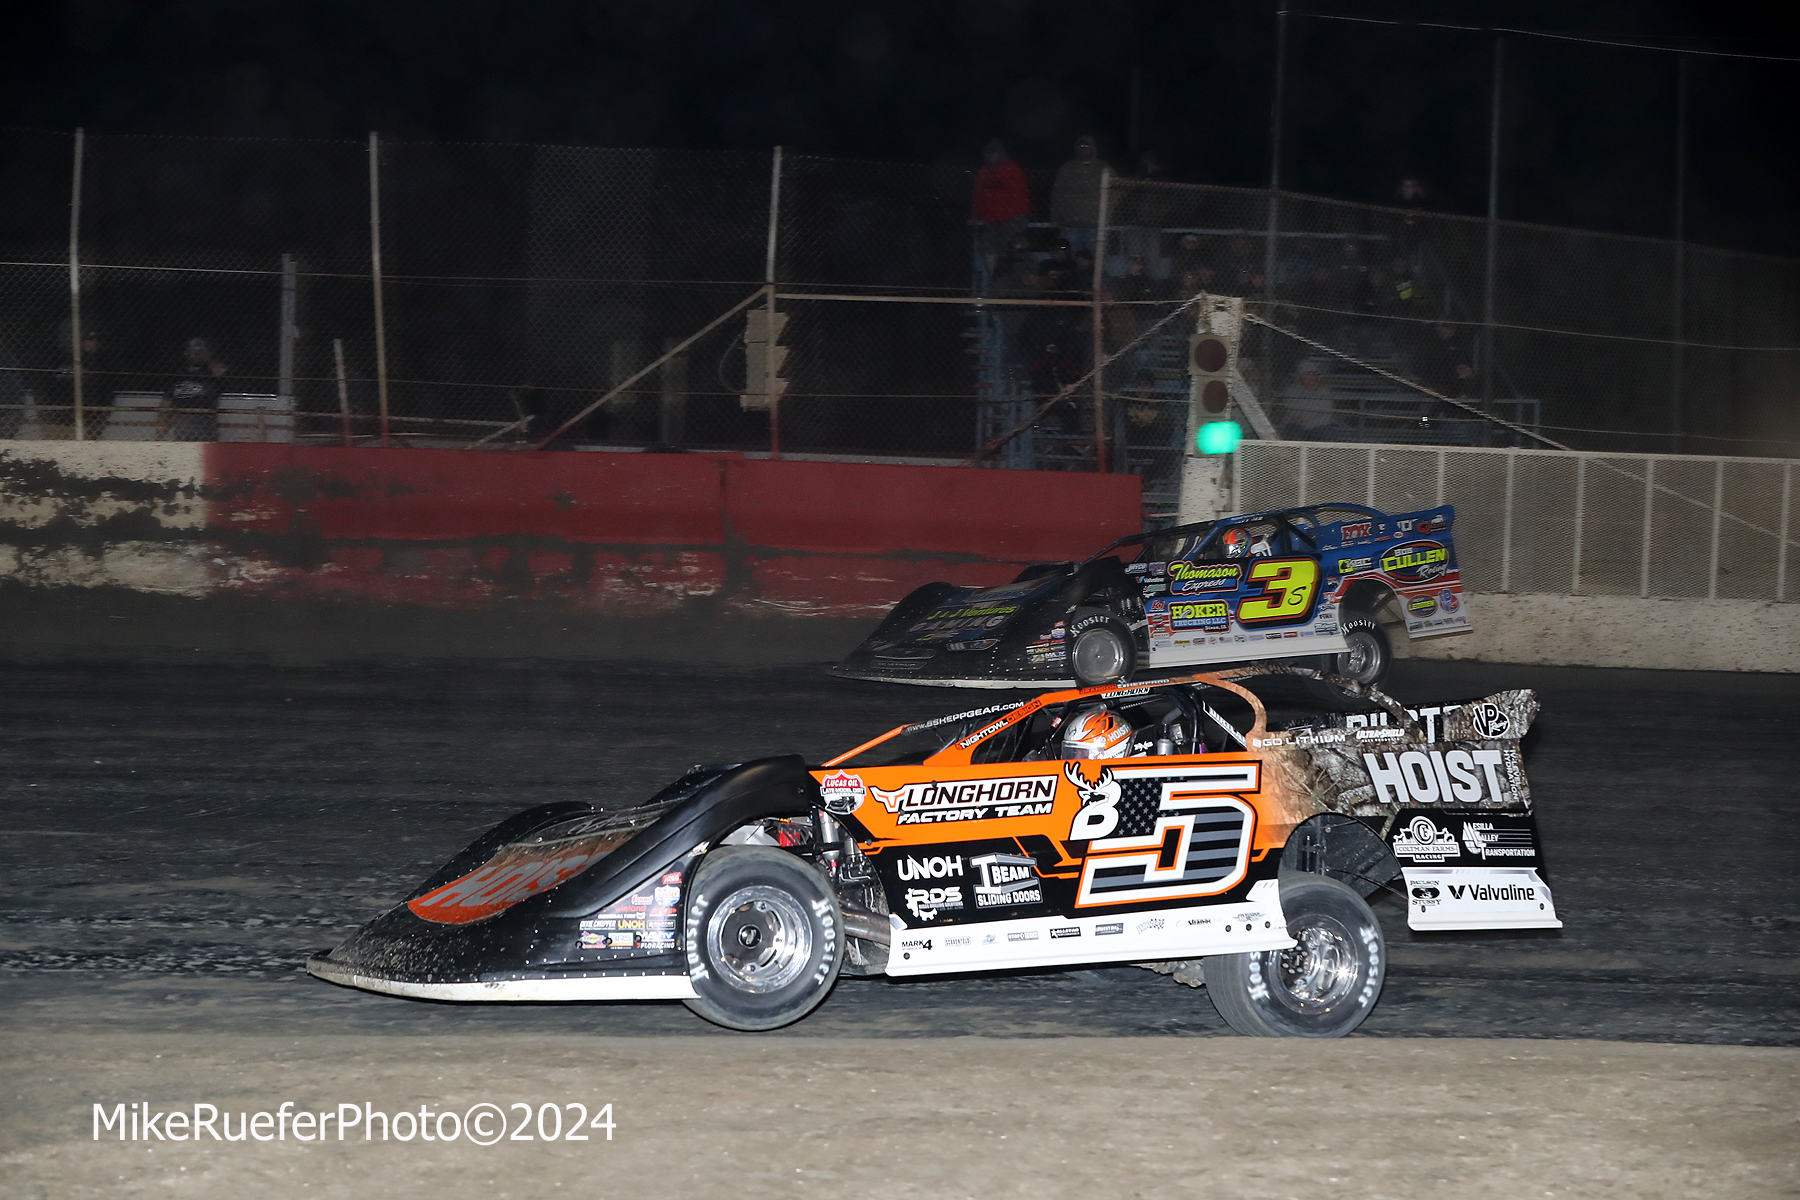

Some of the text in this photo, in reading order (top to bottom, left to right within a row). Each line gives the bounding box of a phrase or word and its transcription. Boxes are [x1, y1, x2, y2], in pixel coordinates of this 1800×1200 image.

[1382, 548, 1447, 571] CULLEN
[1394, 547, 1413, 557] BOB
[1170, 563, 1239, 581] Thomason
[1416, 563, 1447, 577] Racing
[1182, 578, 1226, 592] Express
[1171, 603, 1228, 620] HOKER
[1070, 614, 1110, 638] Hoosier
[1173, 617, 1227, 627] TRUCKING LLC
[1340, 618, 1376, 636] Hoosier
[1473, 703, 1499, 737] VP
[1262, 734, 1346, 747] GO LITHIUM
[848, 779, 858, 787] OIL
[1363, 750, 1503, 803] HOIST
[1503, 750, 1519, 800] HYDRATION
[905, 779, 1054, 807] LONGHORN
[898, 803, 1052, 825] FACTORY TEAM
[897, 854, 964, 881] UNOH
[991, 866, 1030, 884] BEAM
[977, 890, 1041, 906] SLIDING DOORS
[1468, 884, 1536, 901] Valvoline
[617, 920, 646, 929] UNOH
[687, 894, 710, 982] Hoosier
[812, 897, 836, 985] Hoosier
[902, 940, 923, 948] MARK
[1359, 925, 1379, 1008] Hoosier
